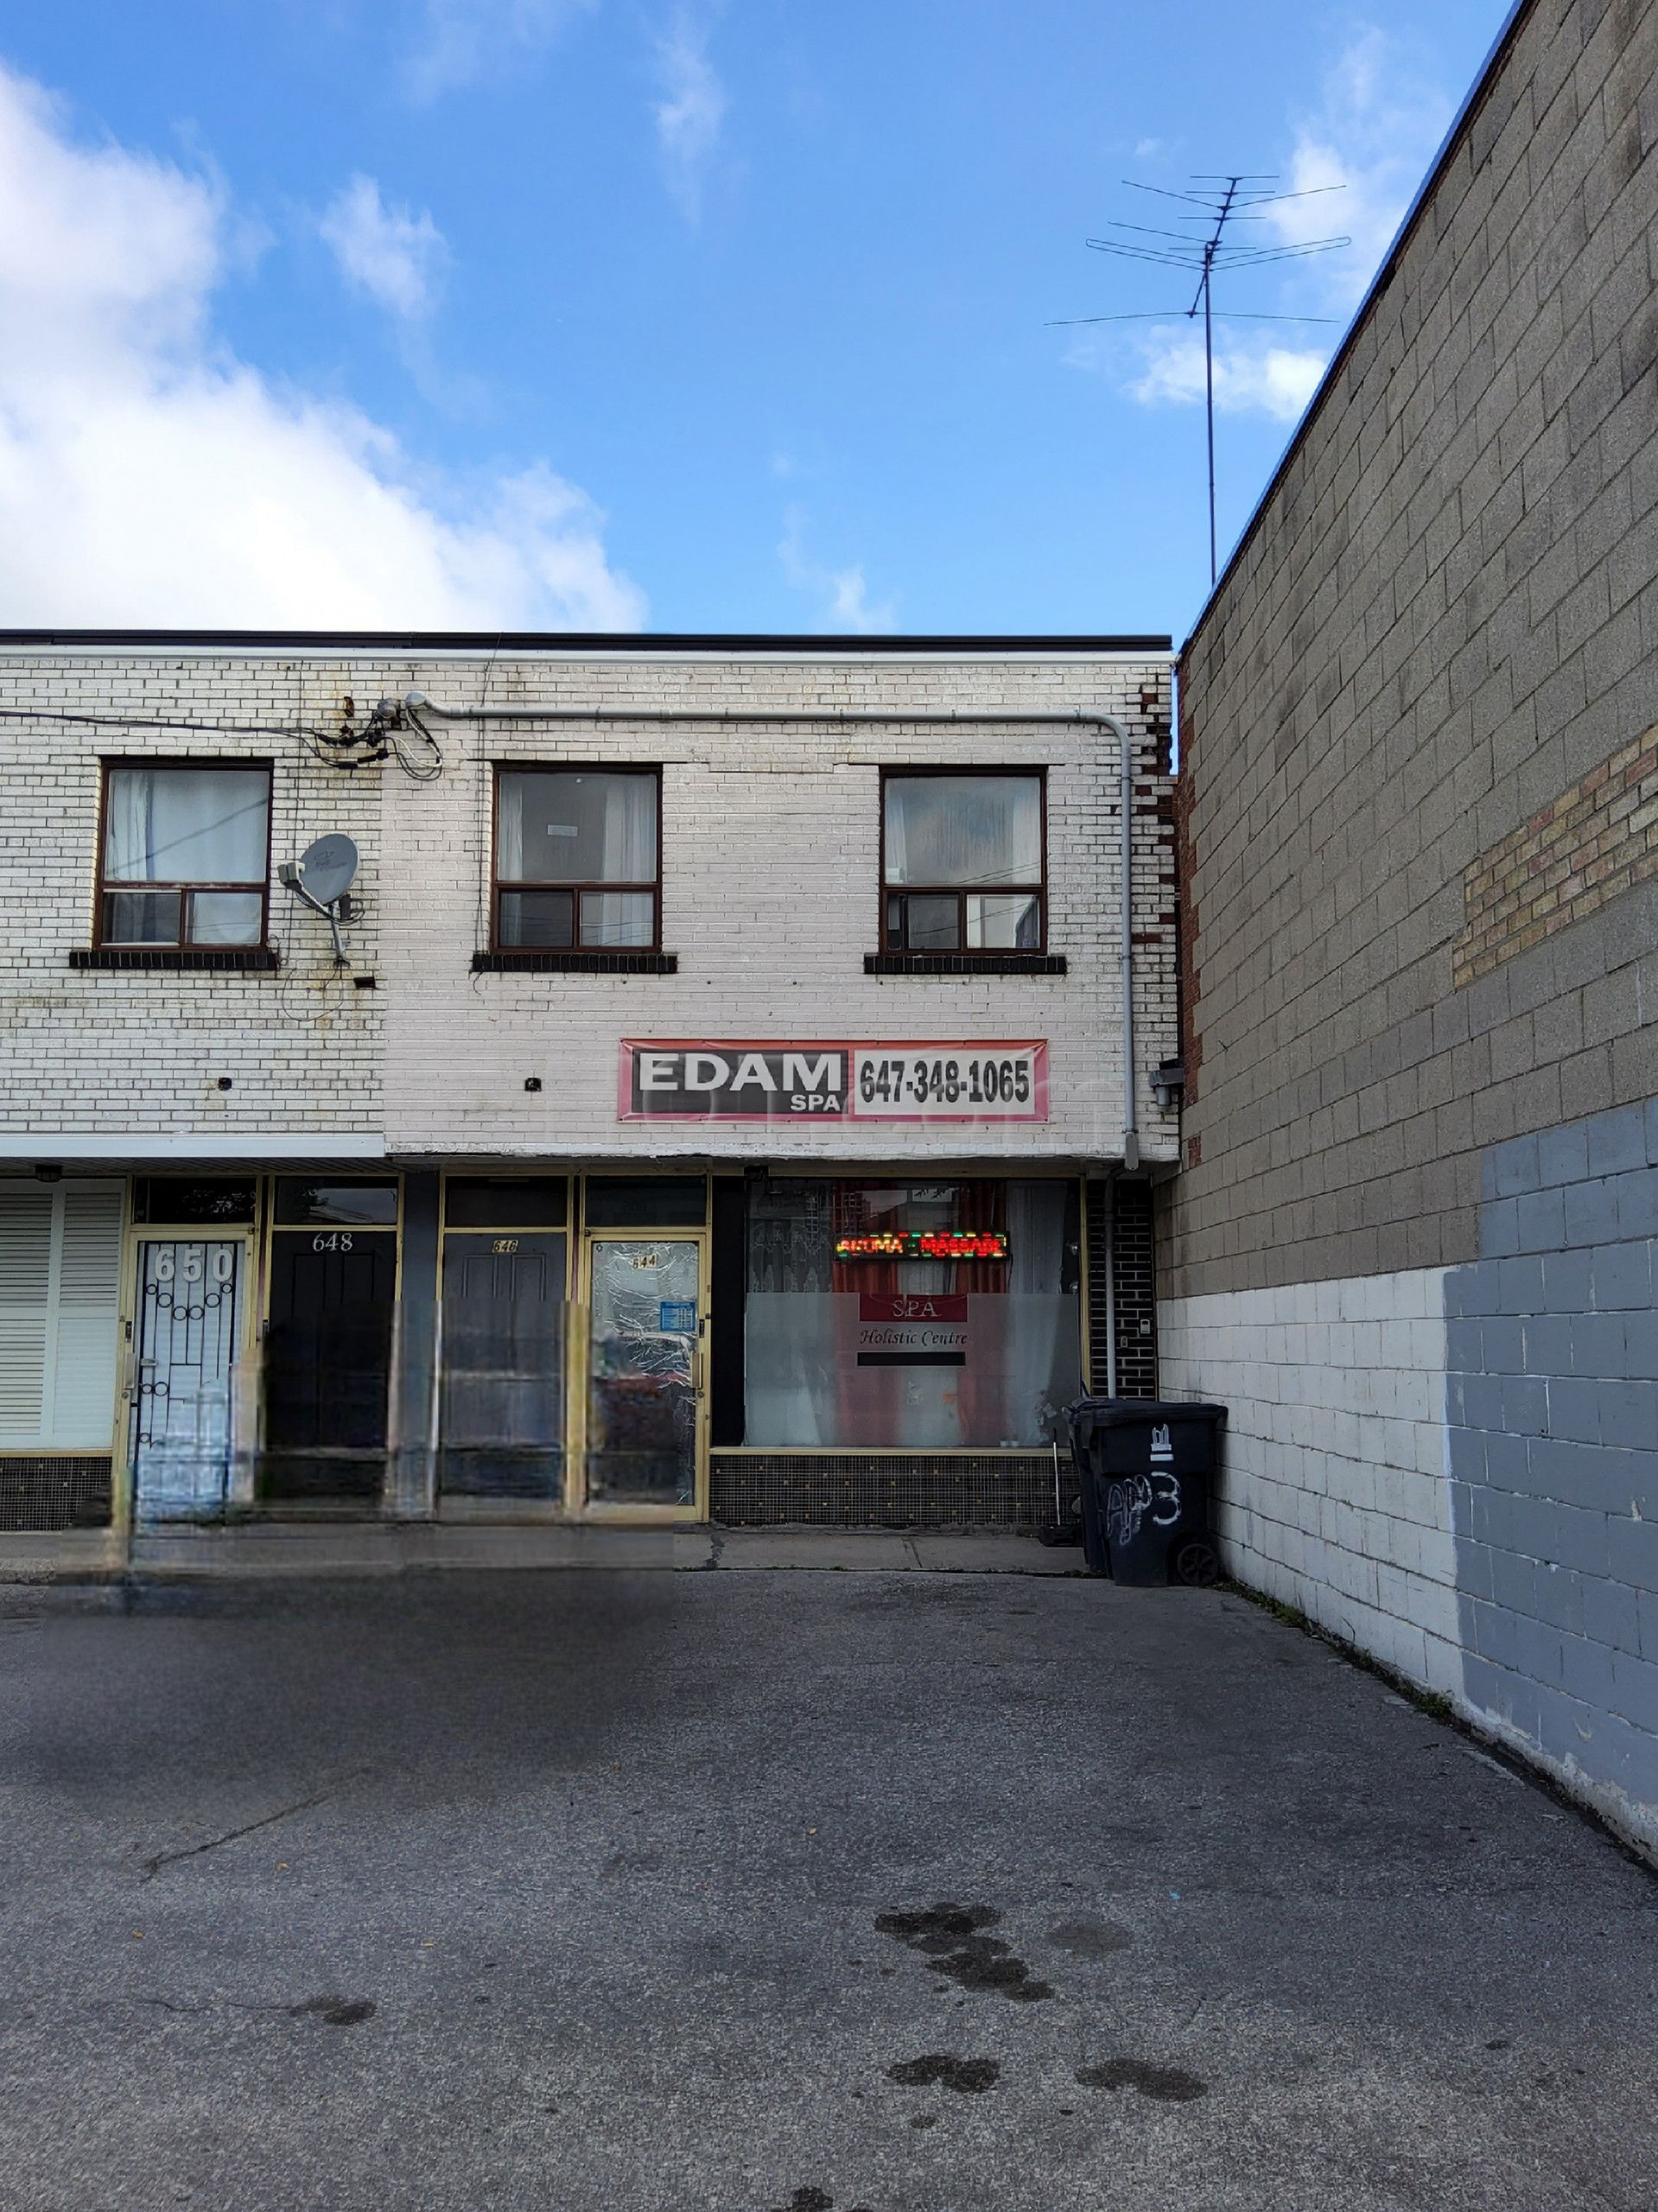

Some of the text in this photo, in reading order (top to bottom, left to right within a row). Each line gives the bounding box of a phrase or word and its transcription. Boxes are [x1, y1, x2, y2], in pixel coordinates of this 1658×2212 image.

[639, 1052, 842, 1091] EDAM
[860, 1059, 1030, 1103] 647-348-1065
[790, 1094, 841, 1112] SPA
[313, 1232, 353, 1251] 648
[493, 1240, 518, 1252] 646
[156, 1249, 232, 1282] 650
[893, 1300, 939, 1317] SPA
[860, 1328, 968, 1346] Holistic Centre
